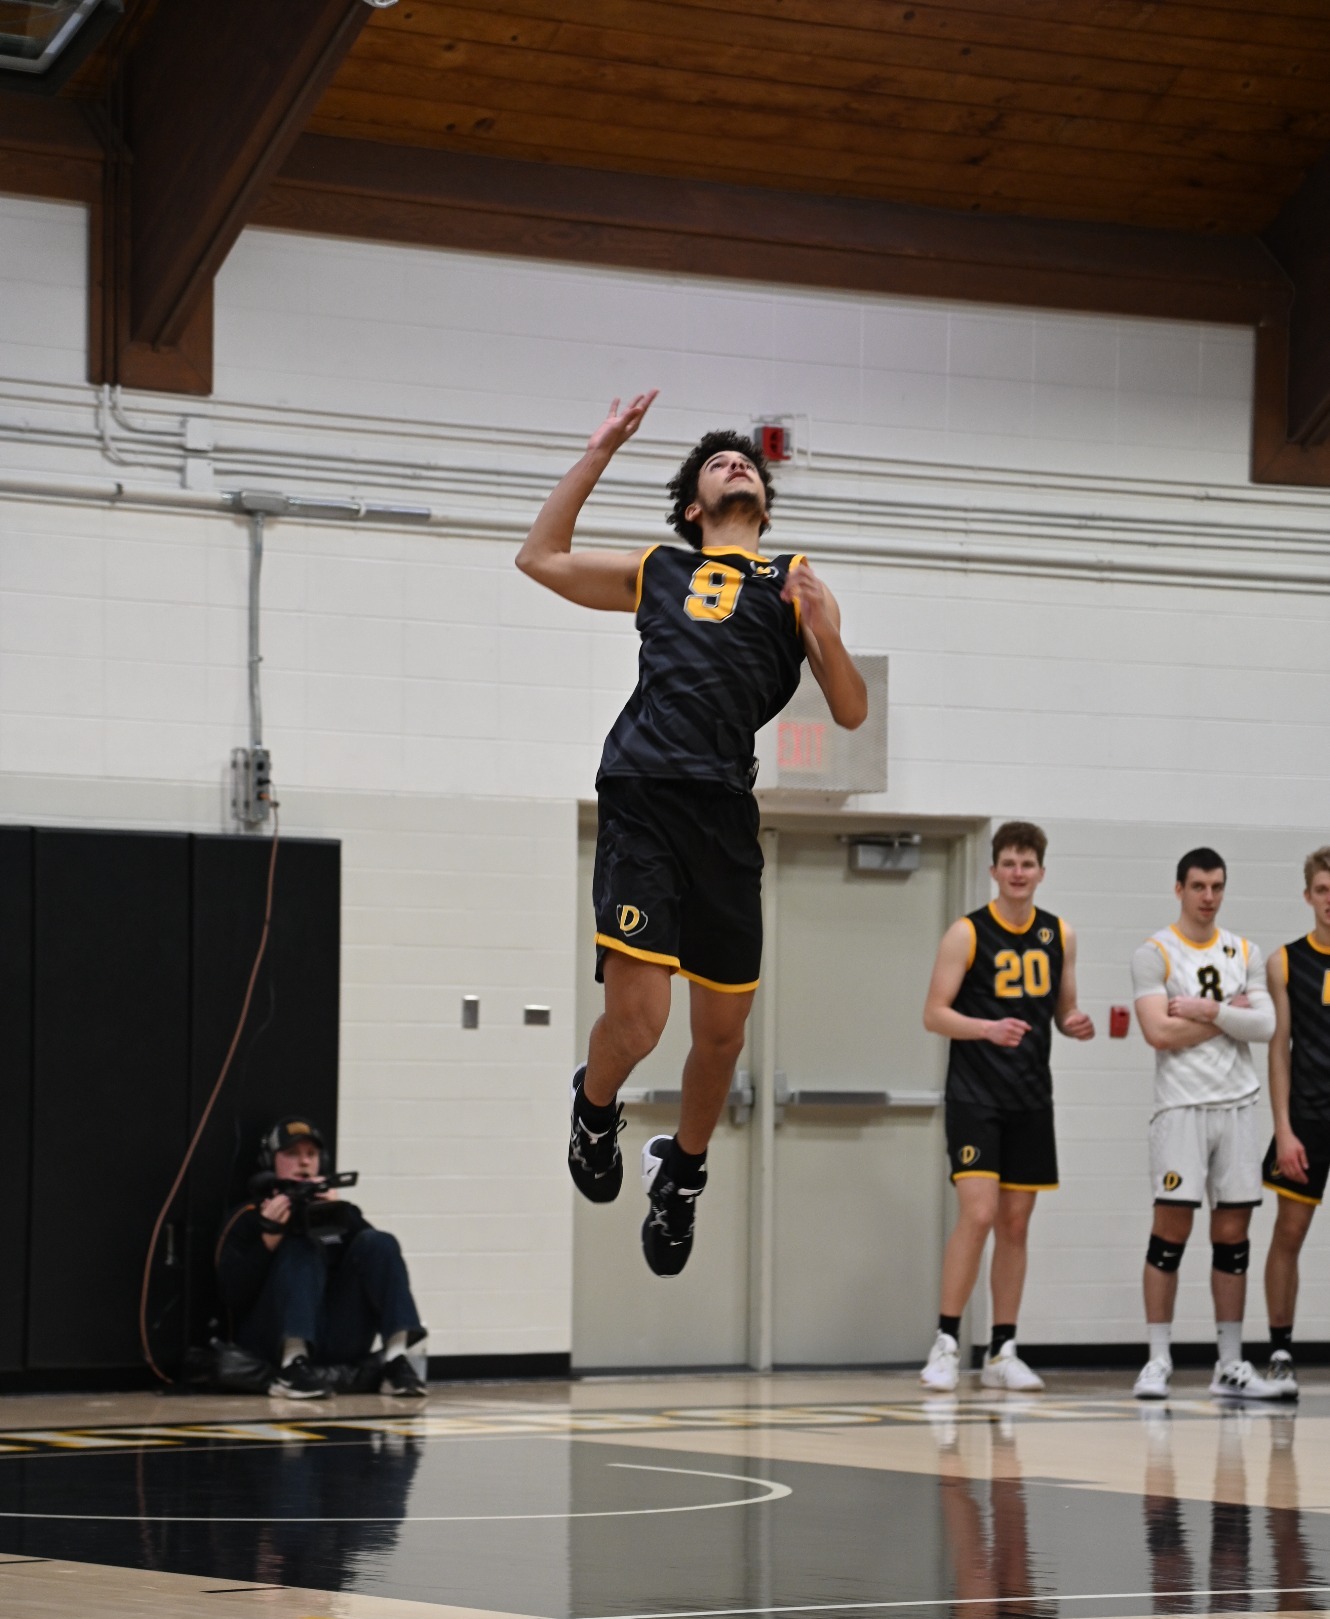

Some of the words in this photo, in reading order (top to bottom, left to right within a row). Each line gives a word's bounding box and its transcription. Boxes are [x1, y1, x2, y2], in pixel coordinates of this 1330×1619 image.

[683, 560, 746, 623] 9
[777, 722, 826, 768] EXIT
[619, 904, 641, 932] D
[994, 949, 1051, 998] 20
[1197, 965, 1224, 1002] 8
